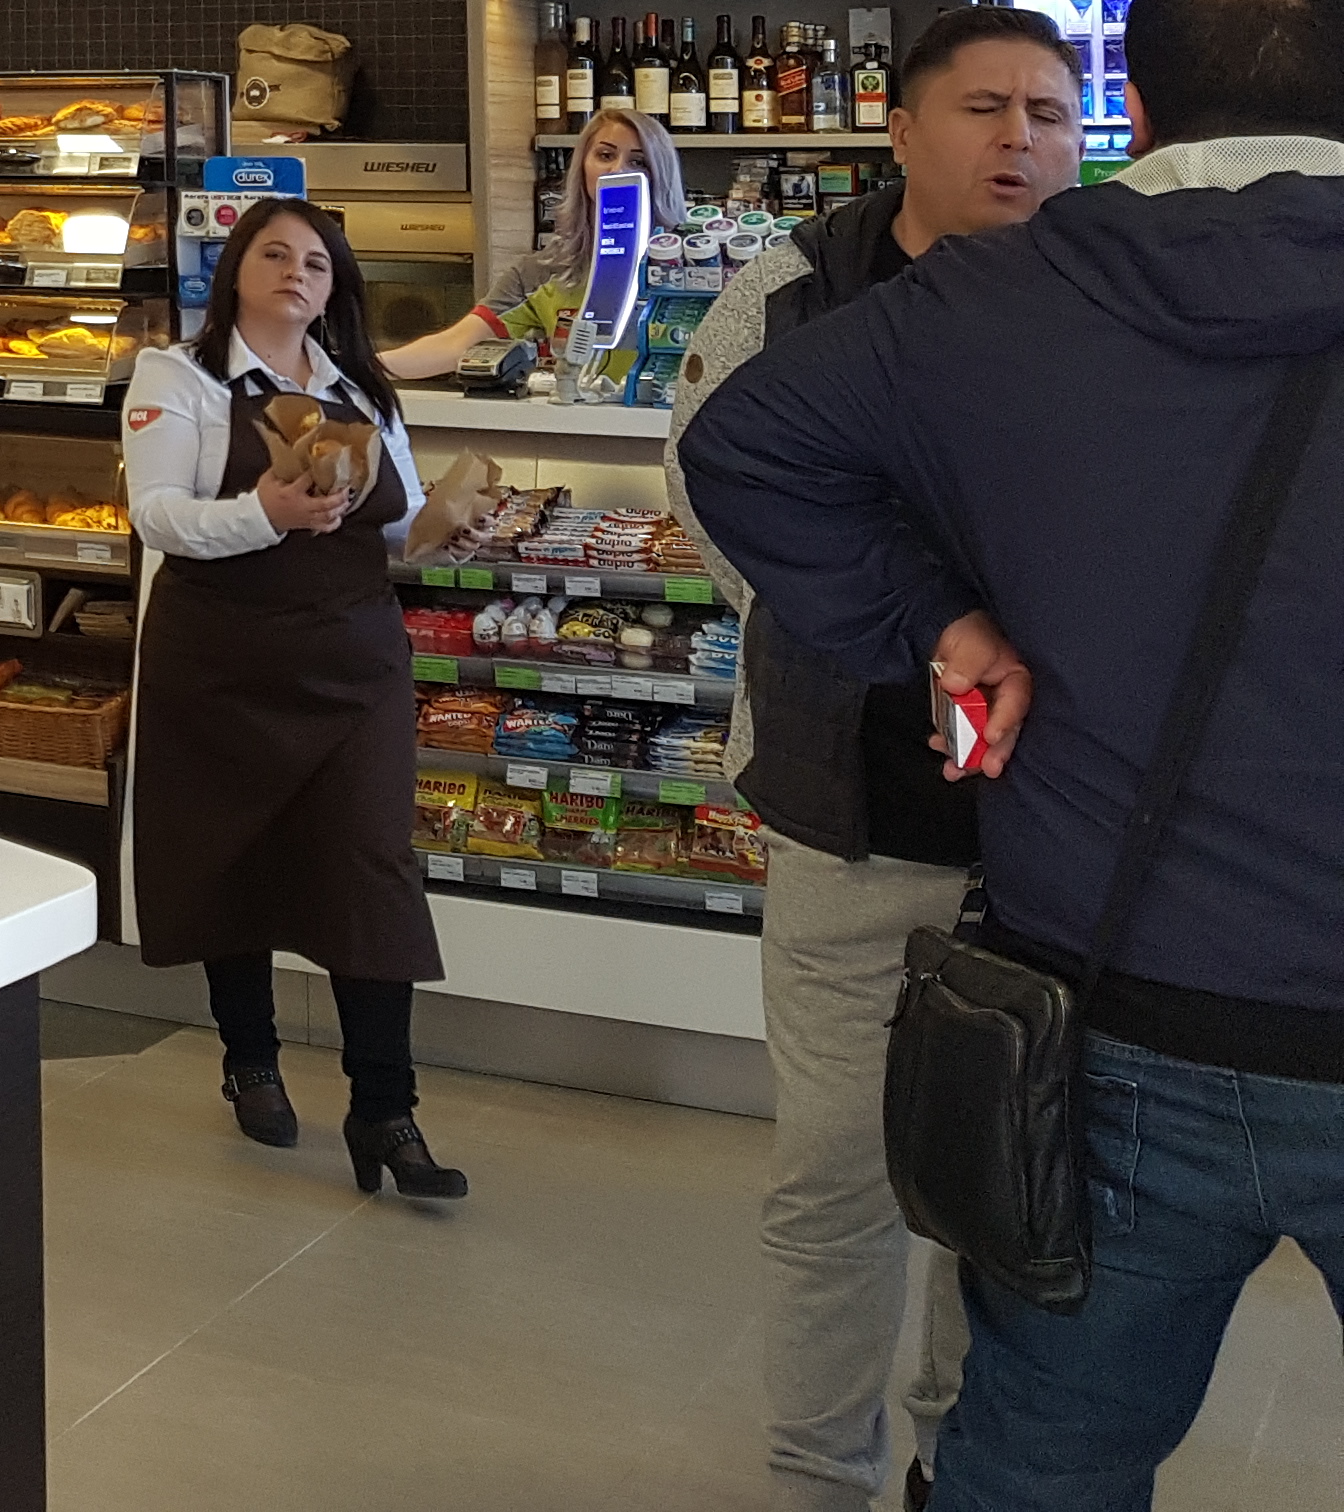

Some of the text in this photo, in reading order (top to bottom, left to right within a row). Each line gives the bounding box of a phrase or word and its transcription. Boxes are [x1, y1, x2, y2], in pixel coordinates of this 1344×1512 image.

[364, 162, 436, 174] WIESHEU
[236, 170, 271, 184] durex
[549, 791, 605, 809] HARIBO
